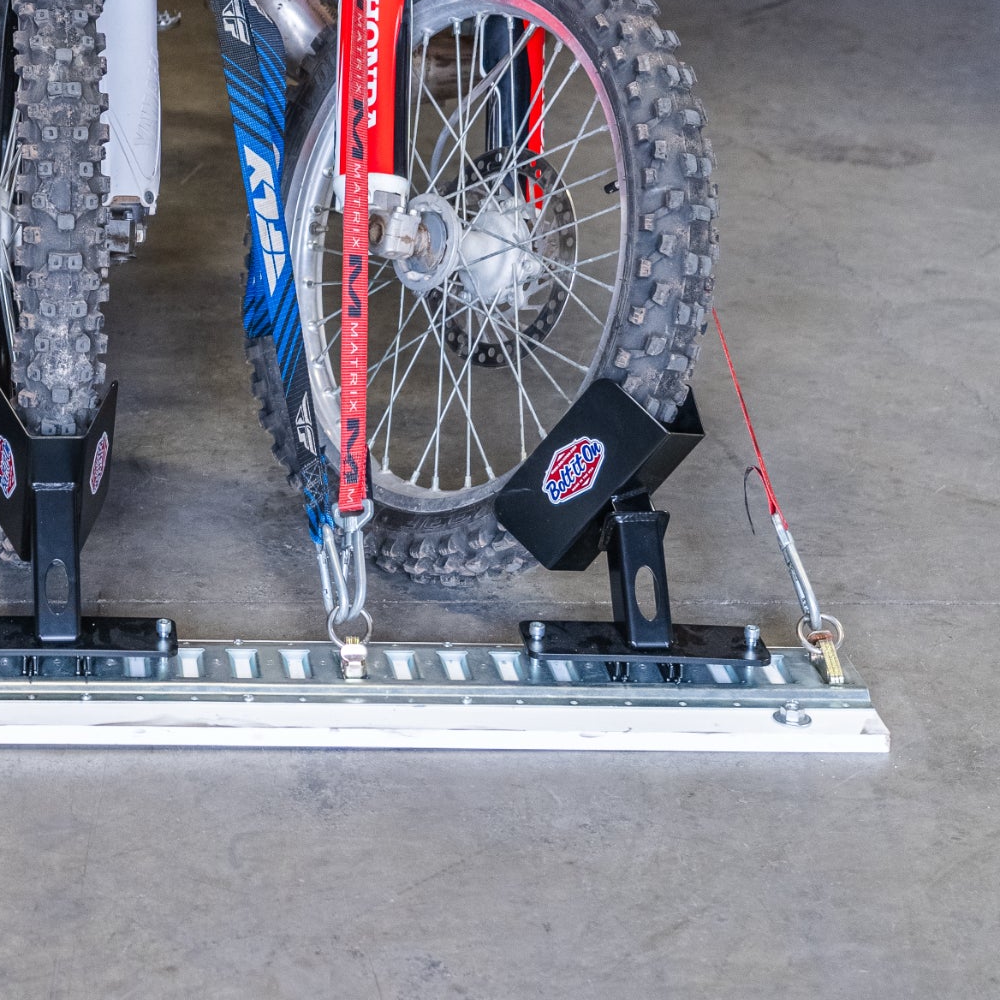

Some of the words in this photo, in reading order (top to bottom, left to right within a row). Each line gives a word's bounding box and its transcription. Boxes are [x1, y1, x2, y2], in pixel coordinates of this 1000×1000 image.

[354, 13, 364, 95] MATRIX
[352, 162, 361, 248] MATRIX
[350, 322, 359, 412] MATRIX
[546, 465, 574, 501] Bolt
[570, 453, 586, 476] it
[582, 442, 601, 462] On
